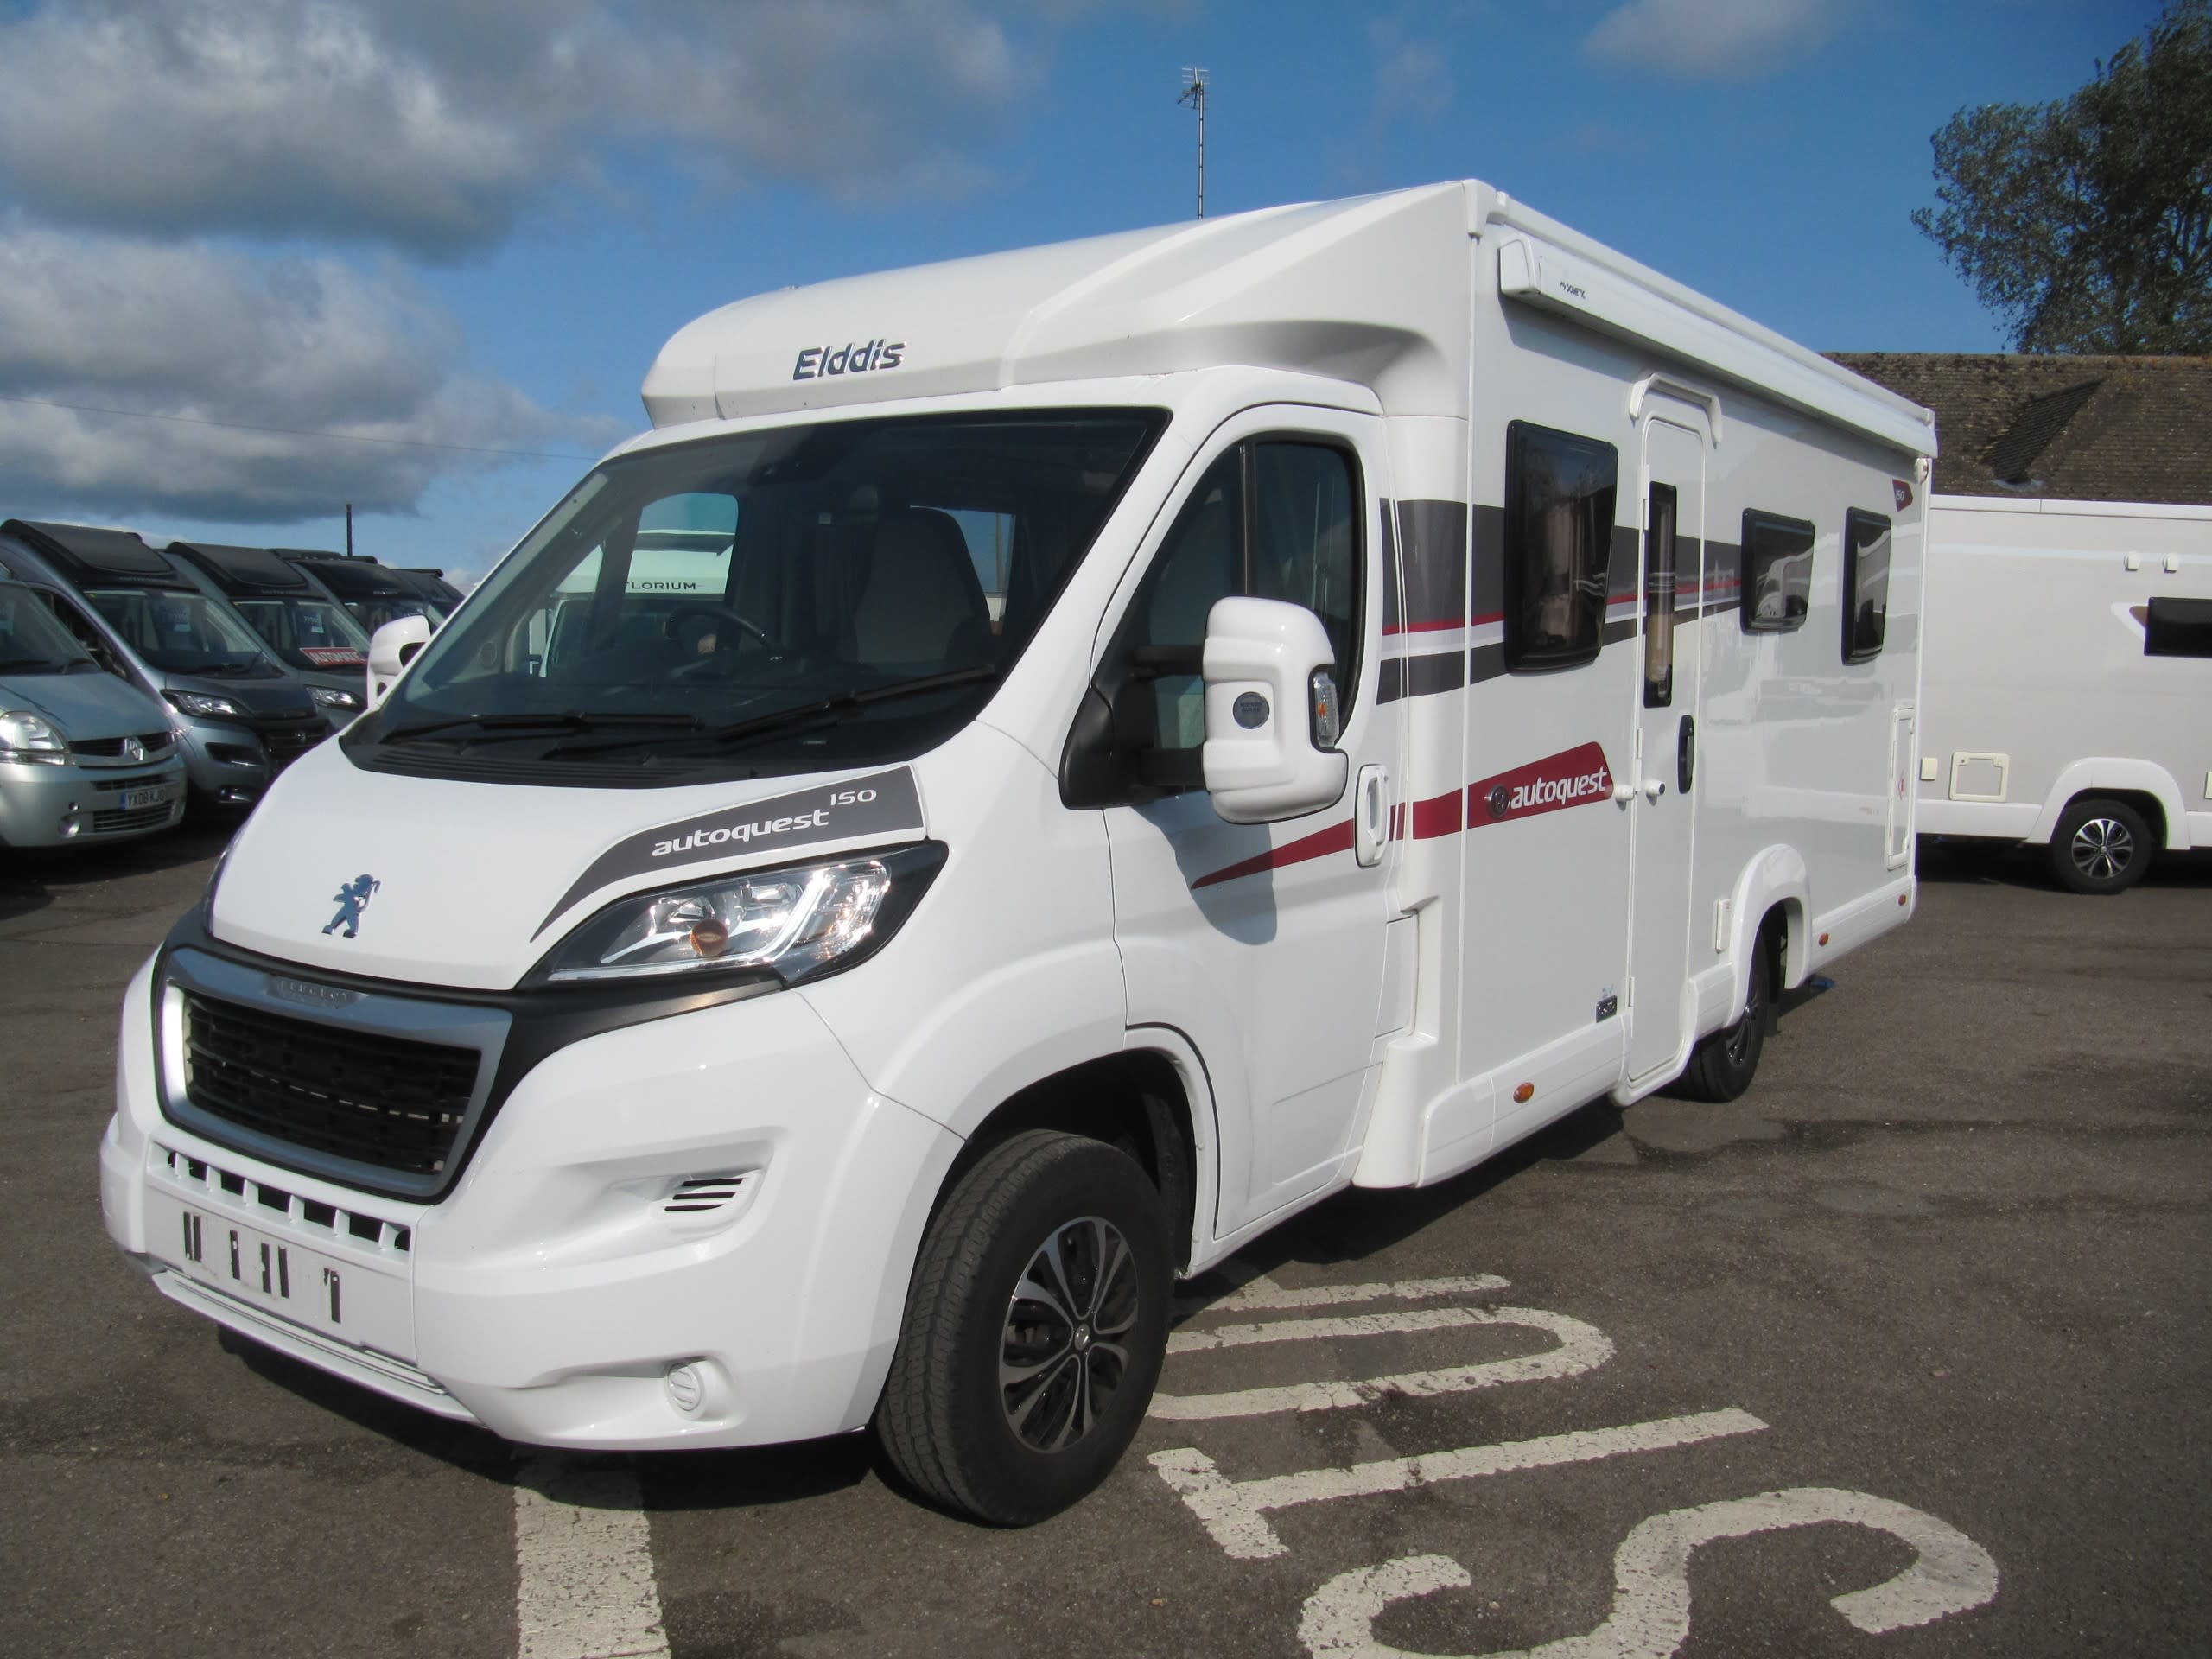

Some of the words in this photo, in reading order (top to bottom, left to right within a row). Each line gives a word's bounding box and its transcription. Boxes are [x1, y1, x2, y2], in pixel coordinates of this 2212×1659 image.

[793, 338, 906, 380] Elddis
[627, 582, 696, 590] LORIUM
[1511, 766, 1607, 809] autoquest
[652, 809, 830, 856] autoquest
[830, 789, 877, 806] 150
